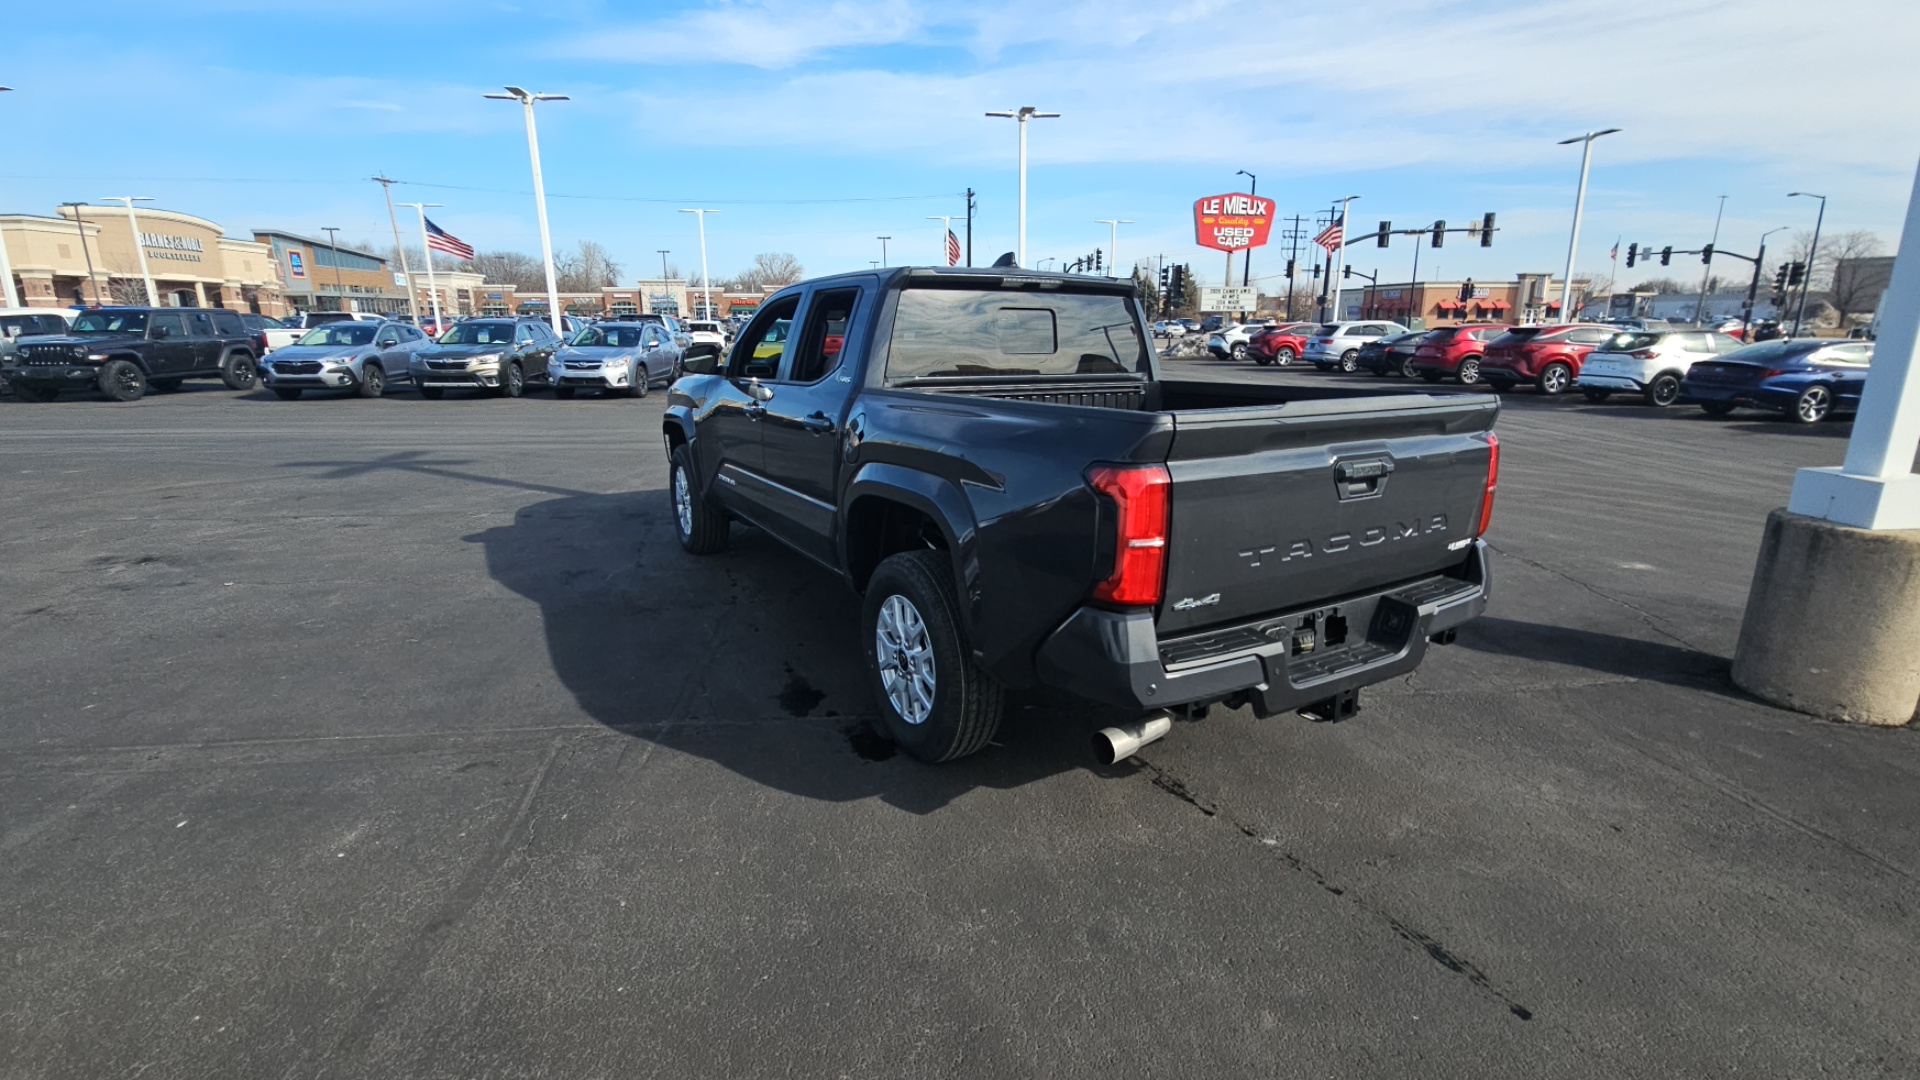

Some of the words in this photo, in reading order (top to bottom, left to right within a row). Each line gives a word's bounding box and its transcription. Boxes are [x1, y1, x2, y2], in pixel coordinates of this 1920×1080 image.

[1203, 199, 1220, 215] LE
[1223, 196, 1267, 216] MIEUX
[1218, 217, 1249, 227] Quality
[1213, 227, 1255, 238] USED
[1217, 236, 1250, 249] CARS
[1238, 513, 1447, 566] TACOMA
